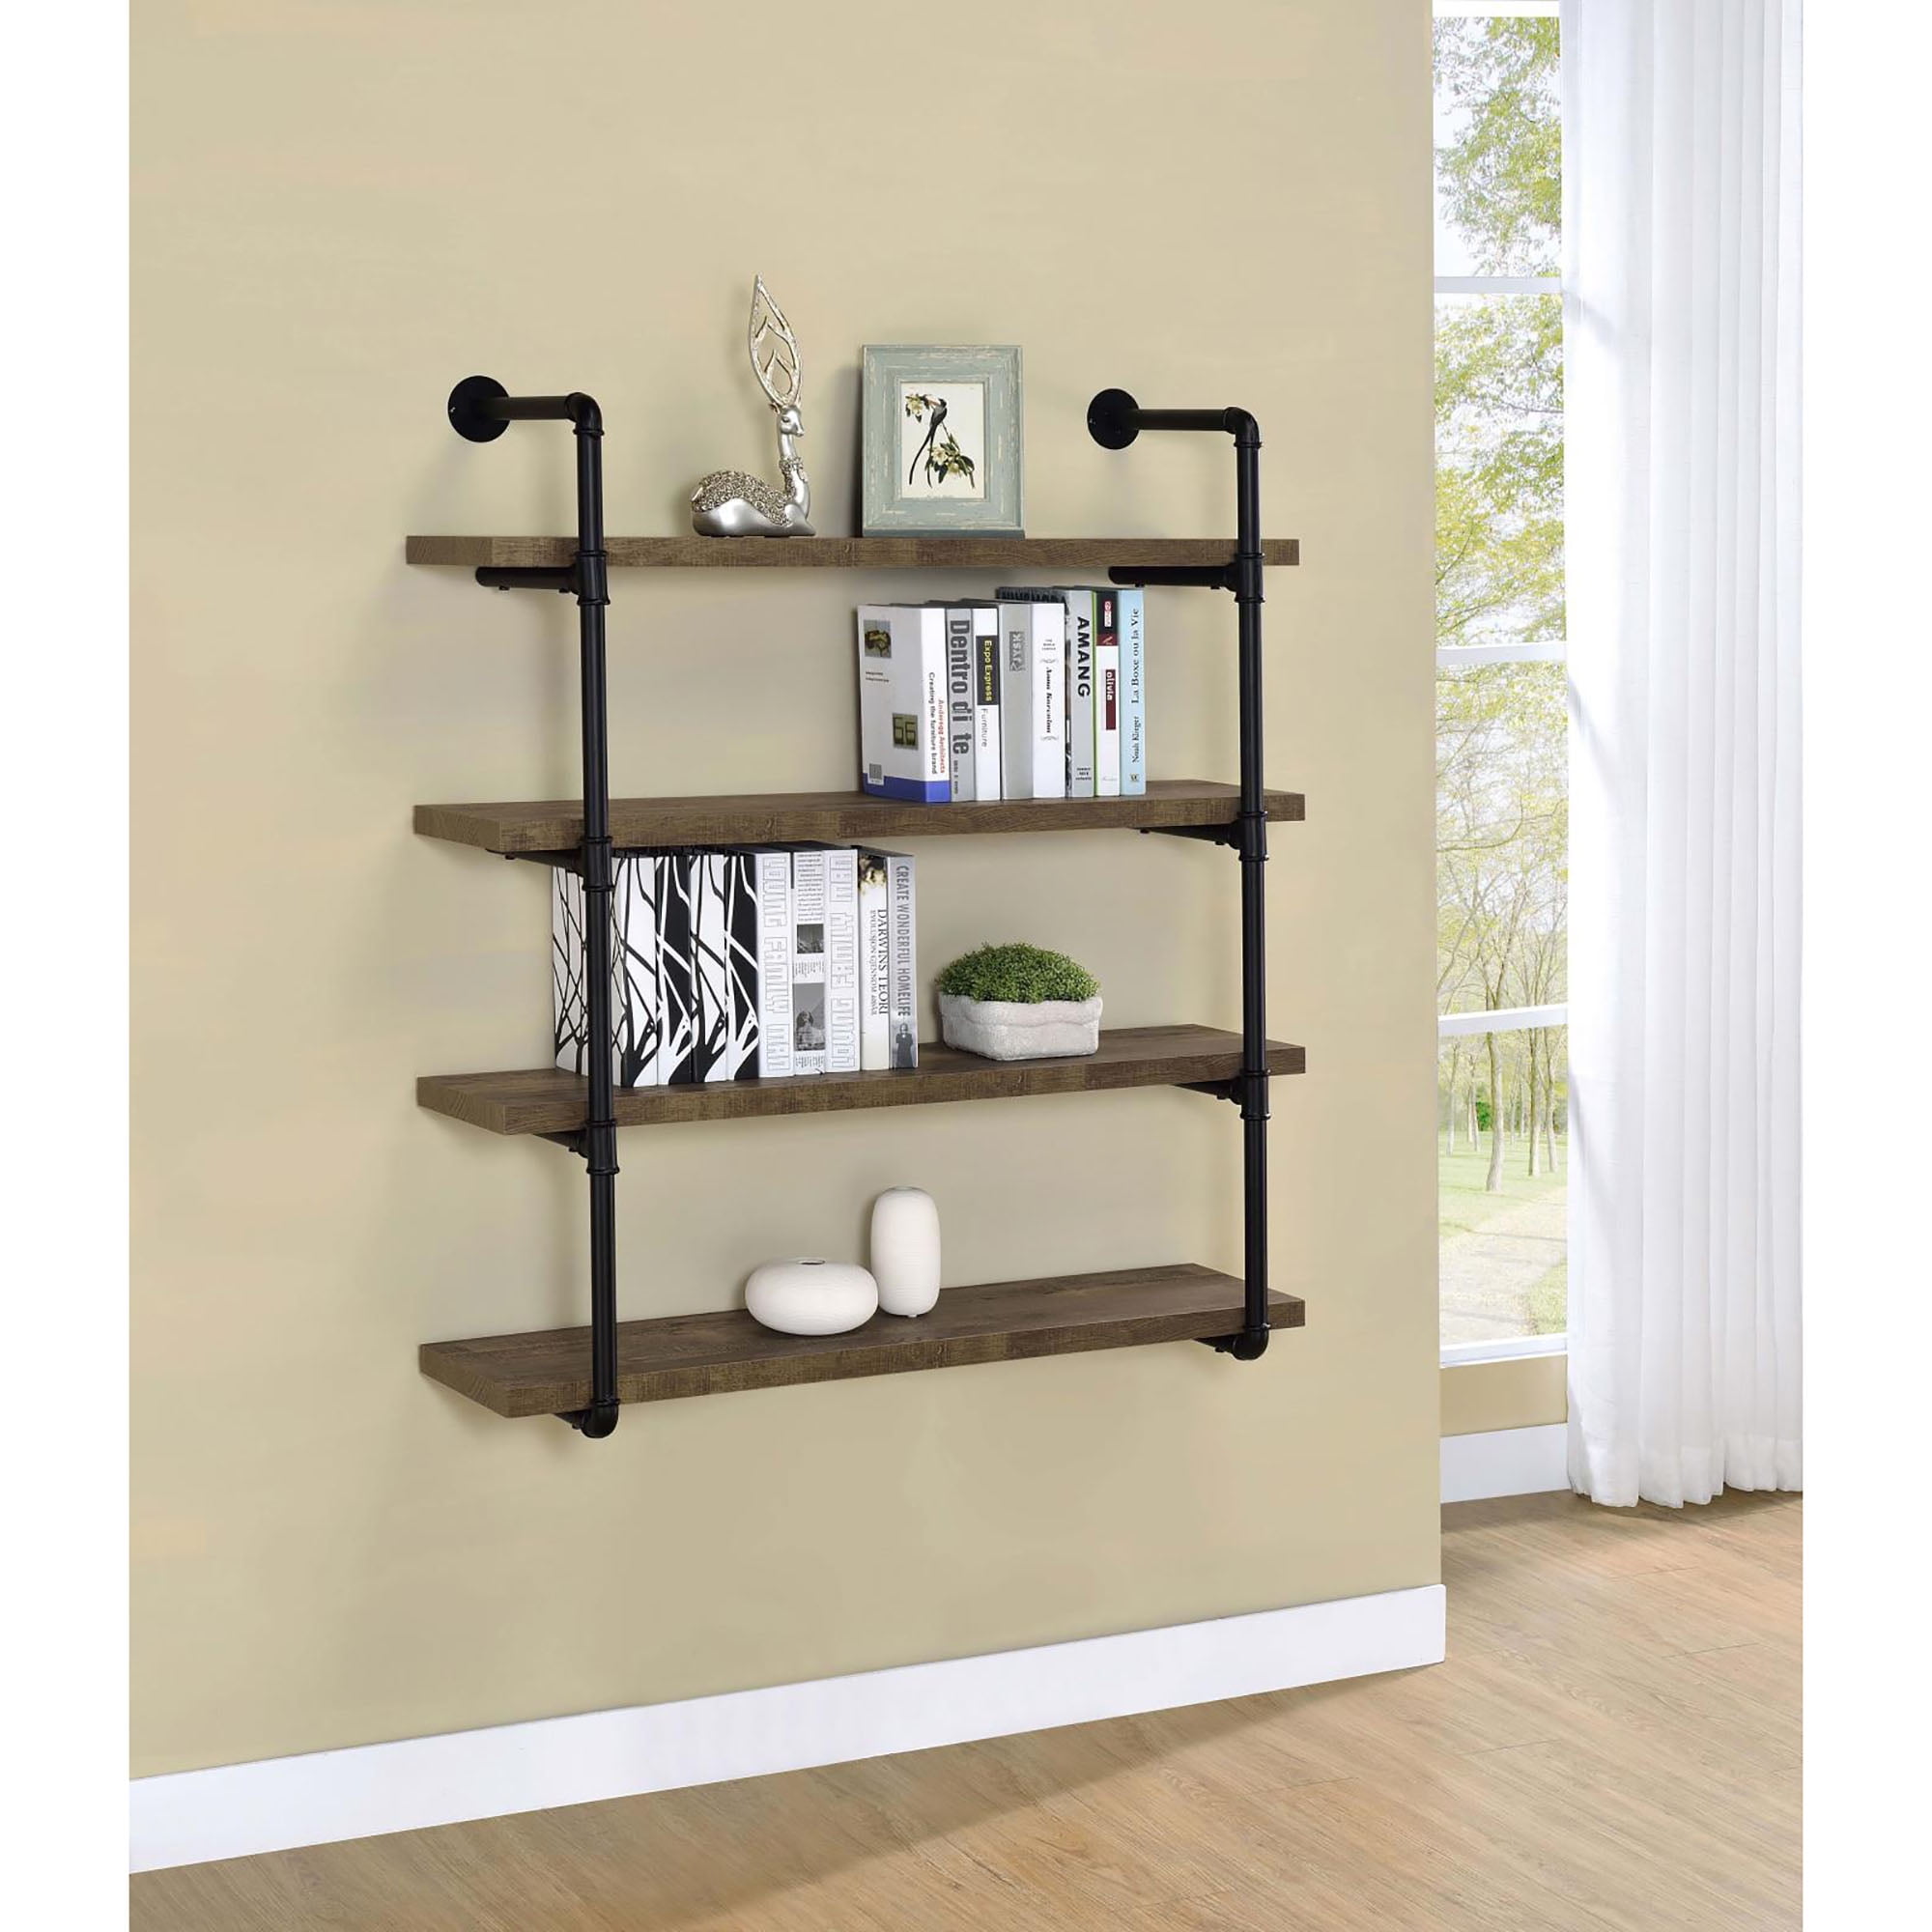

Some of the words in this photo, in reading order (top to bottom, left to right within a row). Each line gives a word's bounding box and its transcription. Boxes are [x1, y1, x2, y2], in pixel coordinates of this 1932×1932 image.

[1130, 609, 1140, 626] Vie
[1130, 629, 1140, 639] la
[950, 619, 971, 694] Dentro
[983, 639, 992, 664] Expo
[1012, 634, 1022, 663] JYSK
[1077, 616, 1091, 697] AMANG
[1131, 642, 1140, 656] ou
[983, 665, 993, 701] Express
[1106, 671, 1115, 701] olivia
[1130, 659, 1140, 686] Boxe
[952, 701, 972, 722] di
[1130, 690, 1140, 703] La
[952, 733, 972, 754] te
[1131, 743, 1141, 763] Noah
[762, 856, 787, 927] LOVING
[829, 855, 853, 902] MAN
[896, 865, 910, 900] CREATE
[830, 912, 854, 989] FAMILY
[877, 909, 889, 972] DARWINS
[896, 903, 910, 964] WONDERFUL
[763, 936, 789, 1013] FAMILY
[896, 968, 911, 1016] HOMELIFE
[878, 975, 889, 1015] TEORI
[766, 1023, 791, 1070] MAN
[831, 997, 855, 1068] LOVING
